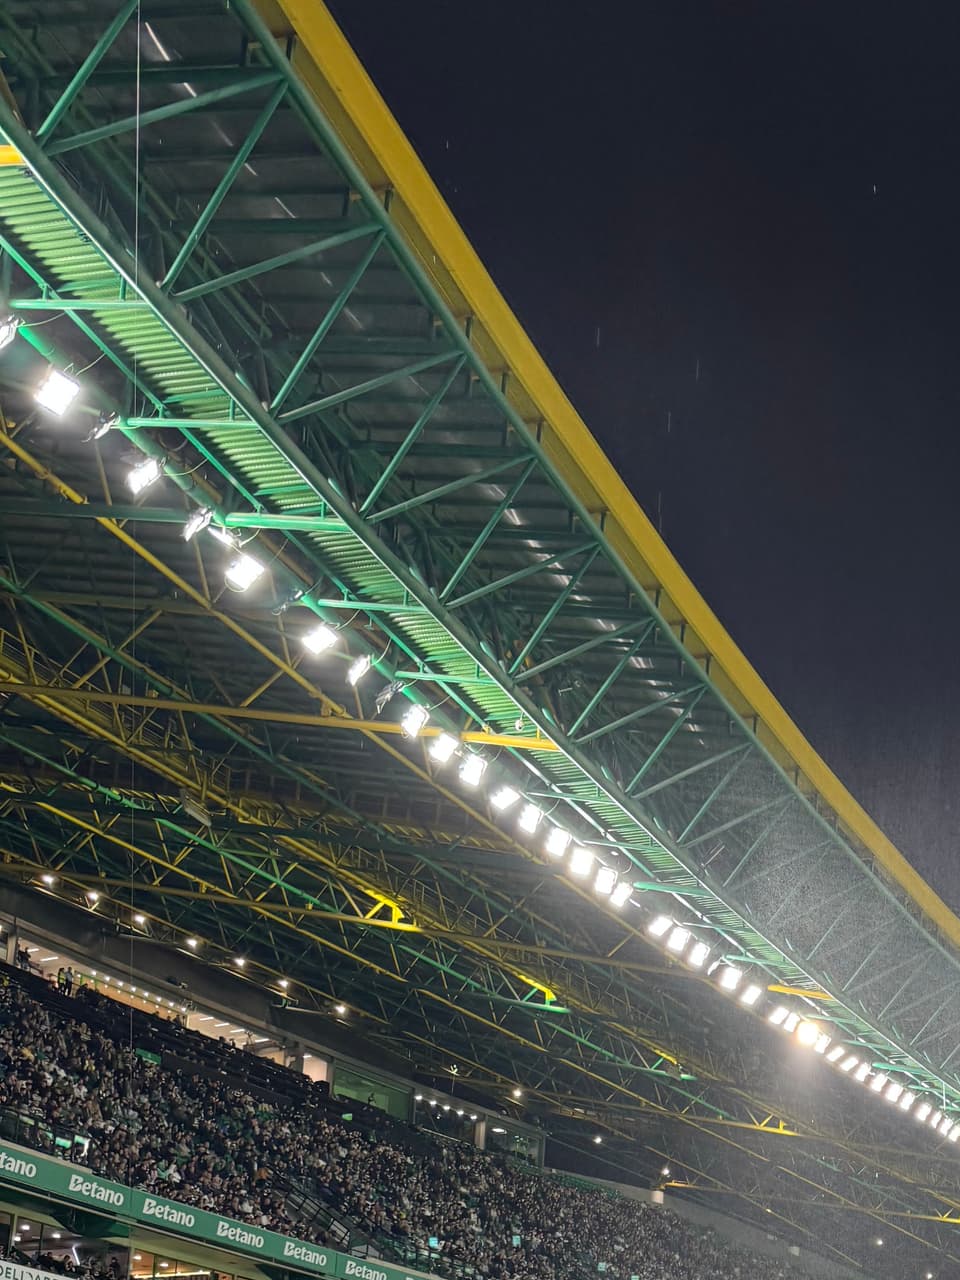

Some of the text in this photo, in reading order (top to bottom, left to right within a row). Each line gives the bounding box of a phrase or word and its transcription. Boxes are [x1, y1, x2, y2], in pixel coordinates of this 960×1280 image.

[0, 1151, 37, 1178] tano
[69, 1174, 124, 1206] Betano
[143, 1198, 195, 1227] Betano
[216, 1221, 264, 1248] Betano
[284, 1241, 327, 1266] Betano
